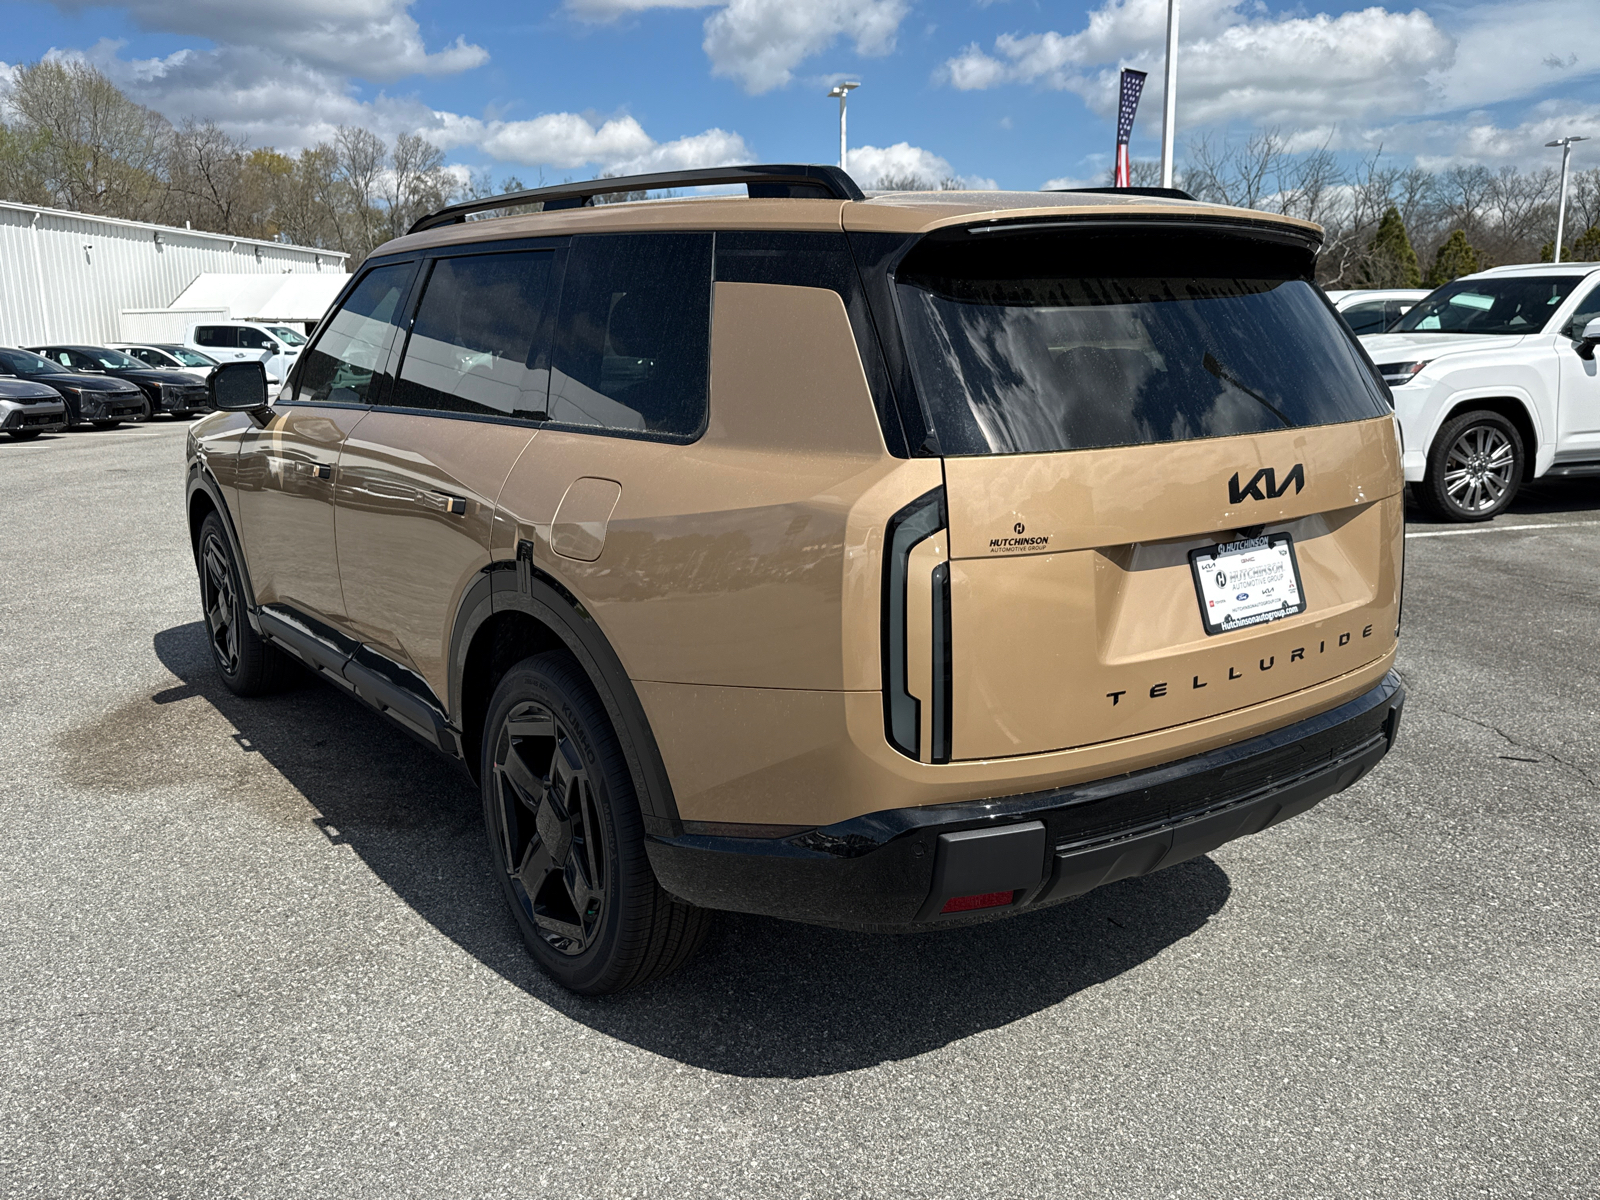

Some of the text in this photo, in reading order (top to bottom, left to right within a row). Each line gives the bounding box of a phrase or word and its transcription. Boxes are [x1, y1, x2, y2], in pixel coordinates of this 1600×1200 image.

[989, 536, 1049, 547] HUTCHINSON
[1226, 536, 1269, 553] HUTCHINSON
[1229, 561, 1284, 583] HUTCHINSON
[1232, 573, 1284, 591] AUTOMOTIVE GROUP
[1221, 606, 1299, 631] Hutchinsonautogroup.com
[1106, 624, 1373, 706] TELLURIDE
[561, 702, 596, 765] KUMHO
[602, 802, 616, 850] Majesty
